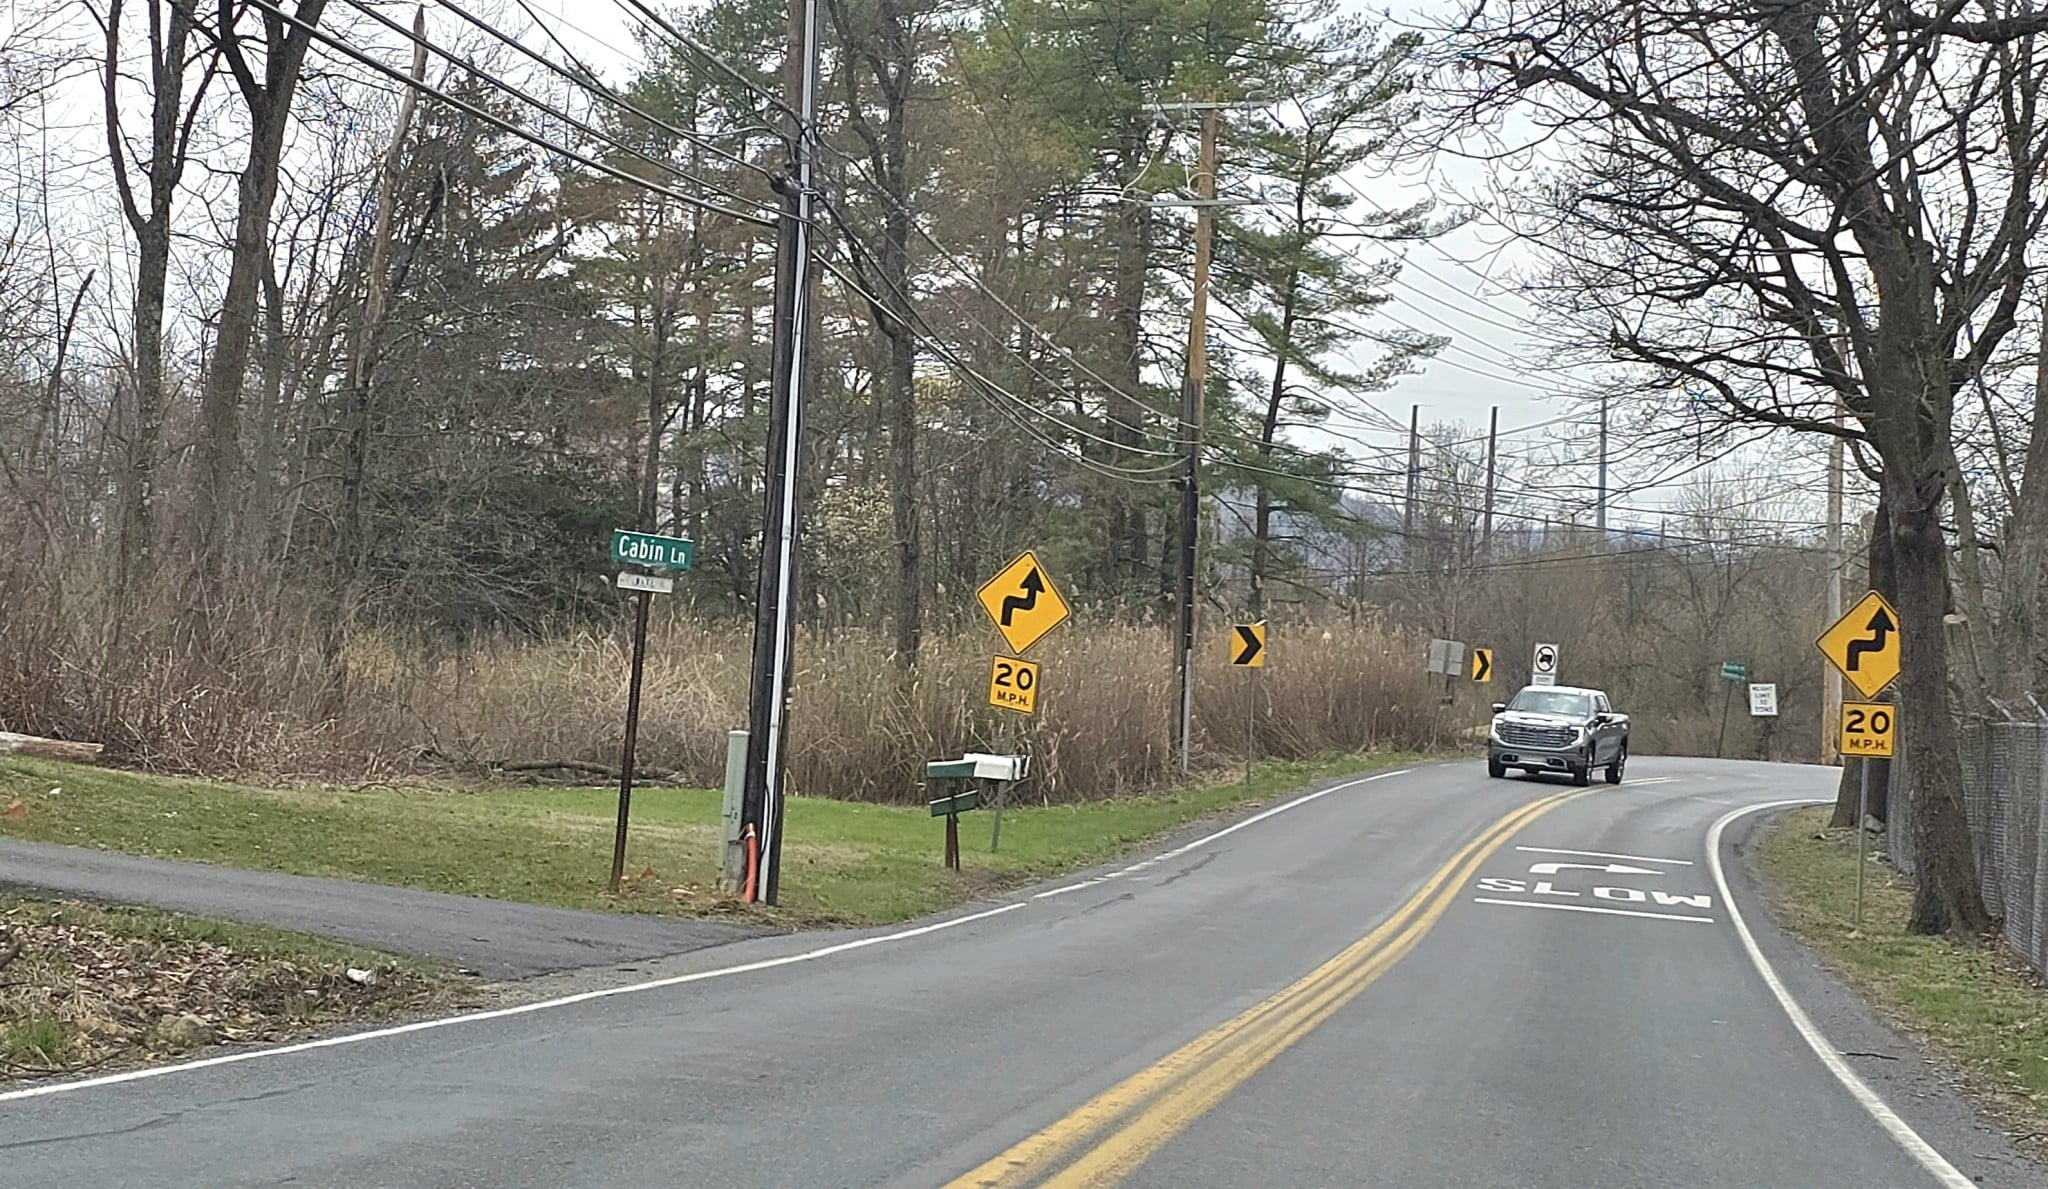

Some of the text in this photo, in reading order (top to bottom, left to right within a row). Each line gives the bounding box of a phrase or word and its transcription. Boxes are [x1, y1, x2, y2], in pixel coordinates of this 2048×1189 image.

[618, 535, 685, 564] Cabin Ln
[995, 663, 1033, 690] 20
[997, 690, 1029, 706] M.P.H.
[1845, 709, 1890, 735] 20
[1849, 738, 1888, 750] M.P.H.
[1475, 878, 1712, 909] SLOW
